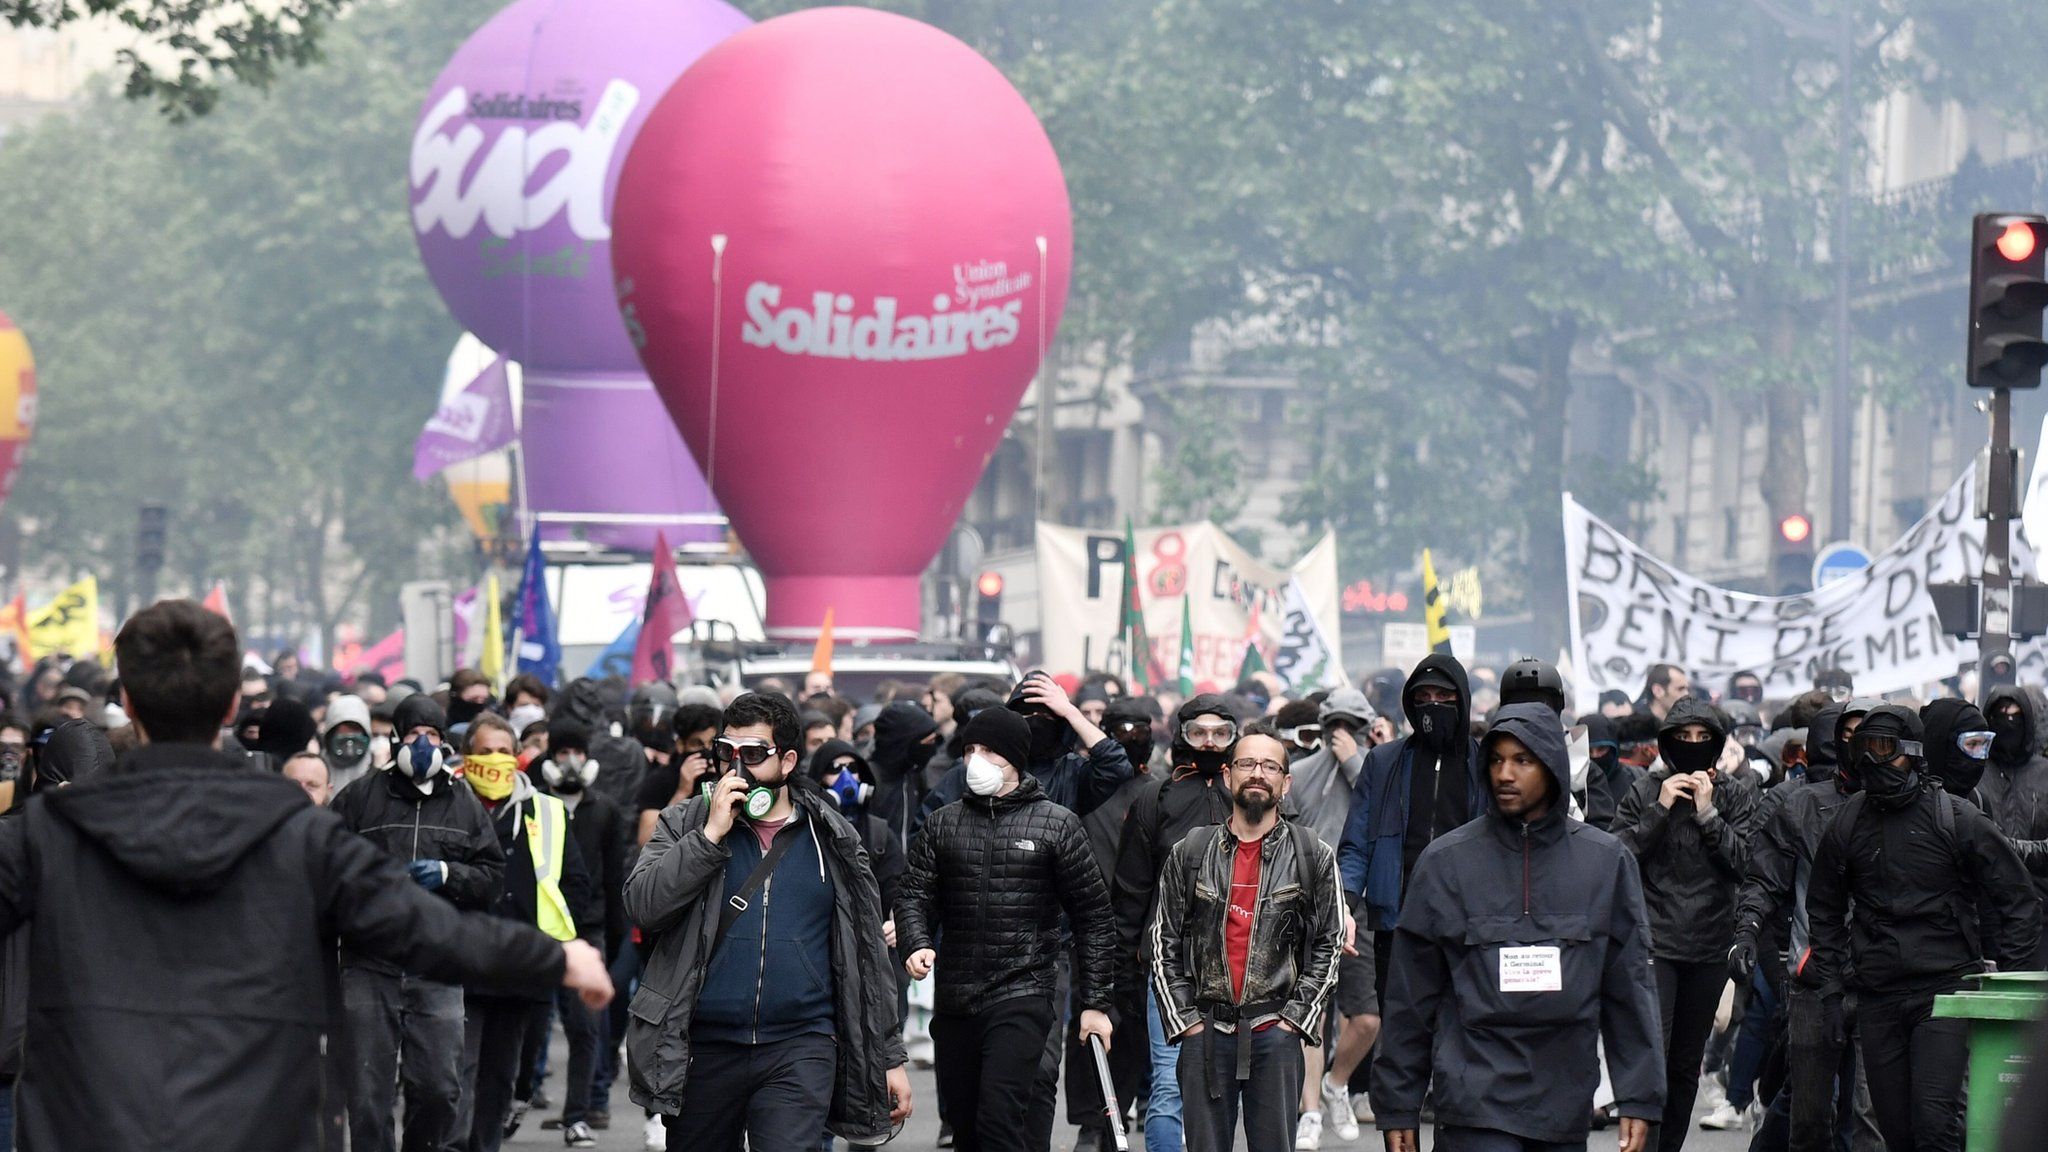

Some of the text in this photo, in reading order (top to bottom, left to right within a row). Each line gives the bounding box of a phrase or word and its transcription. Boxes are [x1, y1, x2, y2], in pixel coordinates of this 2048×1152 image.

[468, 90, 582, 119] Solidaires
[953, 259, 1007, 282] Union
[741, 281, 1022, 361] Solidaires
